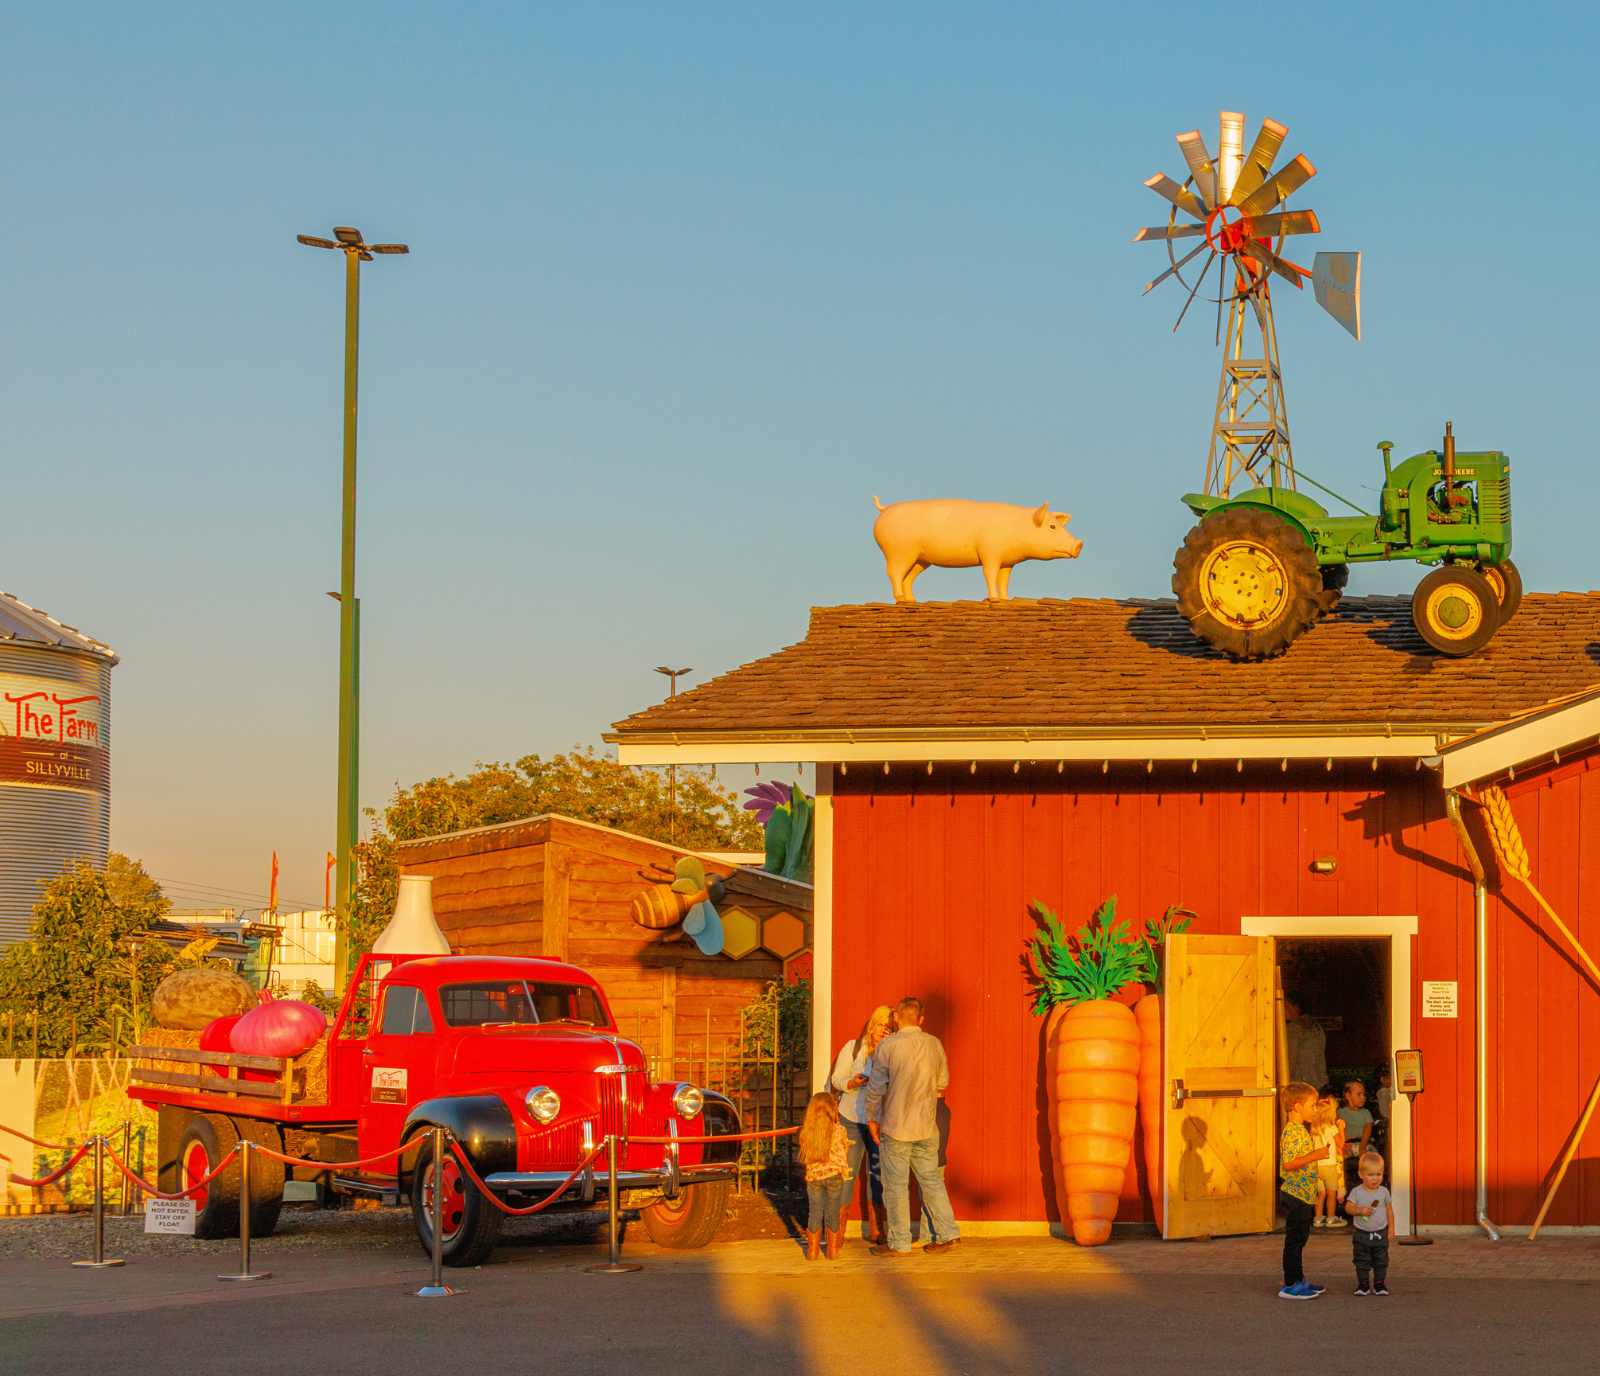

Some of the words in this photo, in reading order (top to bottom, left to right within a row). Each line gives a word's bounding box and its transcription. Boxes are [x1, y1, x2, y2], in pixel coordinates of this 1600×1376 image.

[4, 692, 53, 743] The
[52, 693, 101, 746] Farm
[26, 761, 91, 780] SILLYVILLE
